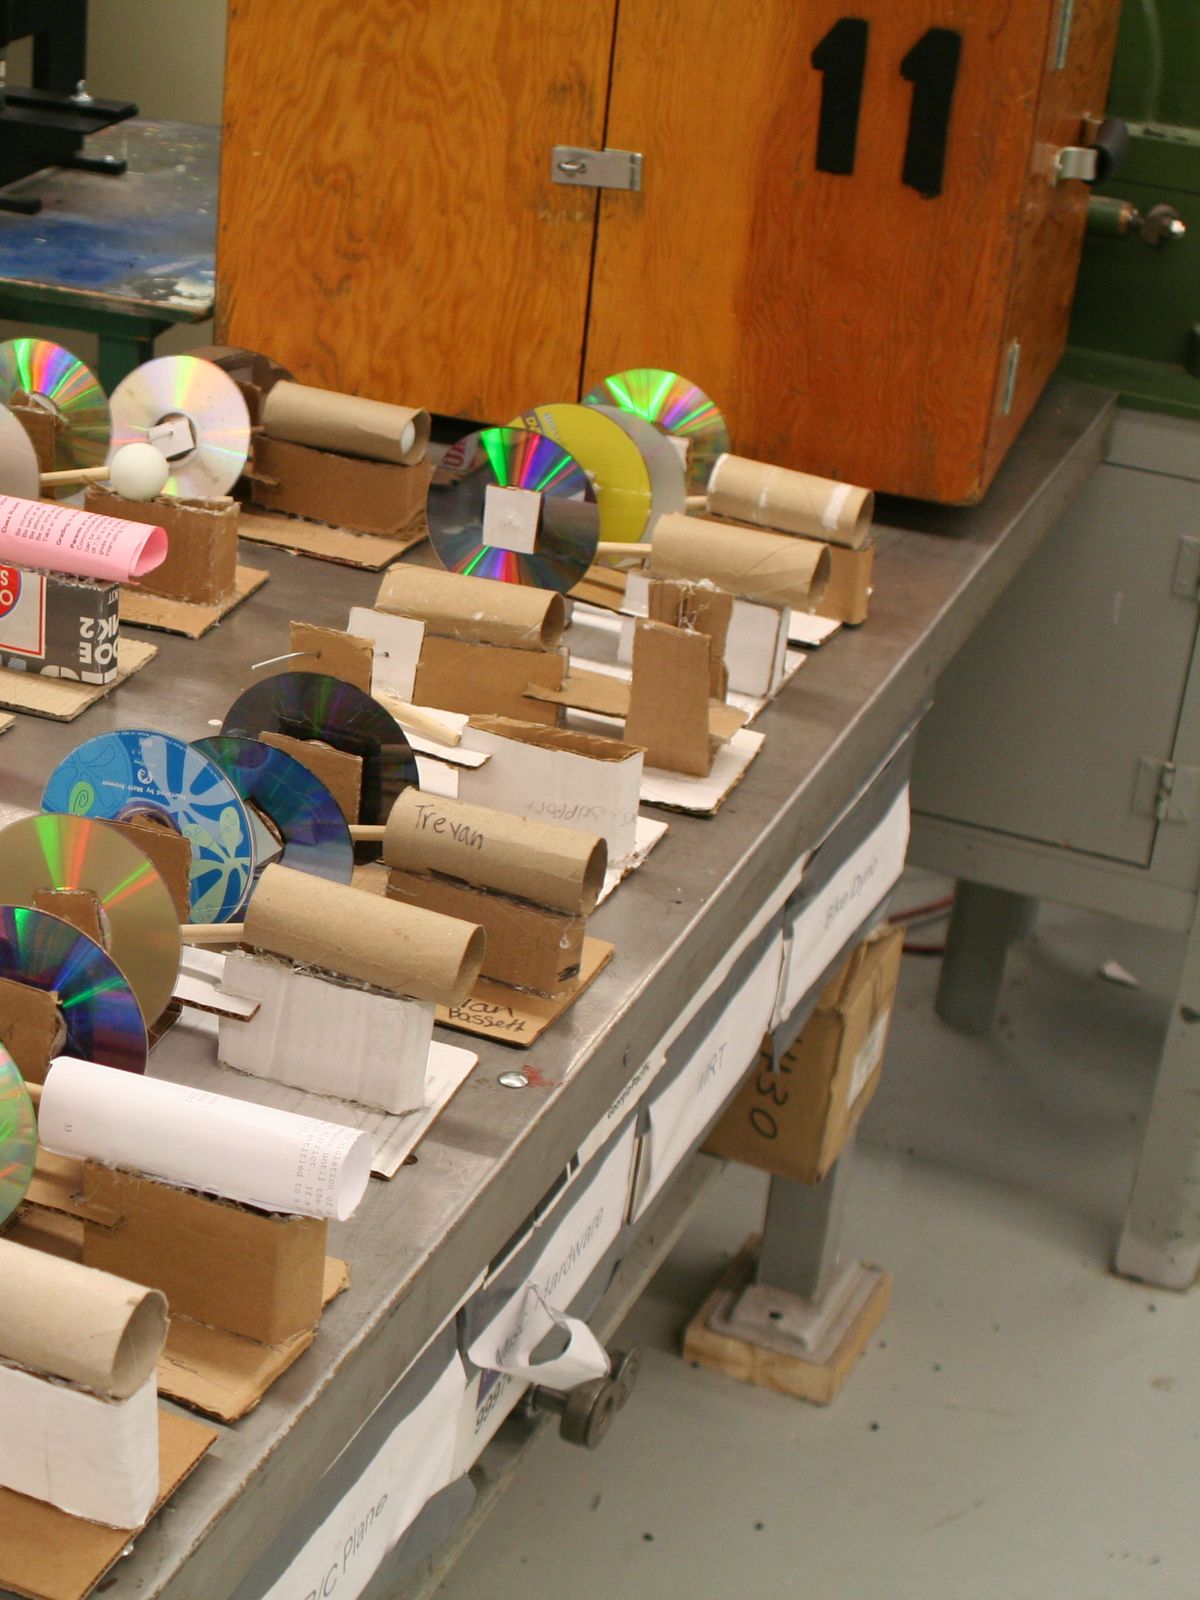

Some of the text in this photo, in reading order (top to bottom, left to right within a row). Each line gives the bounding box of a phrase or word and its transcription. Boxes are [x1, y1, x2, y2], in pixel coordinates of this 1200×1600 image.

[811, 17, 963, 200] 11
[0, 515, 12, 534] Class
[55, 521, 71, 546] Grading
[69, 526, 83, 549] Parents
[127, 783, 144, 793] Matt
[145, 786, 155, 795] by
[414, 803, 485, 851] Trevan
[448, 1006, 528, 1032] Bassett
[317, 1152, 329, 1182] until
[343, 1493, 388, 1574] Plane
